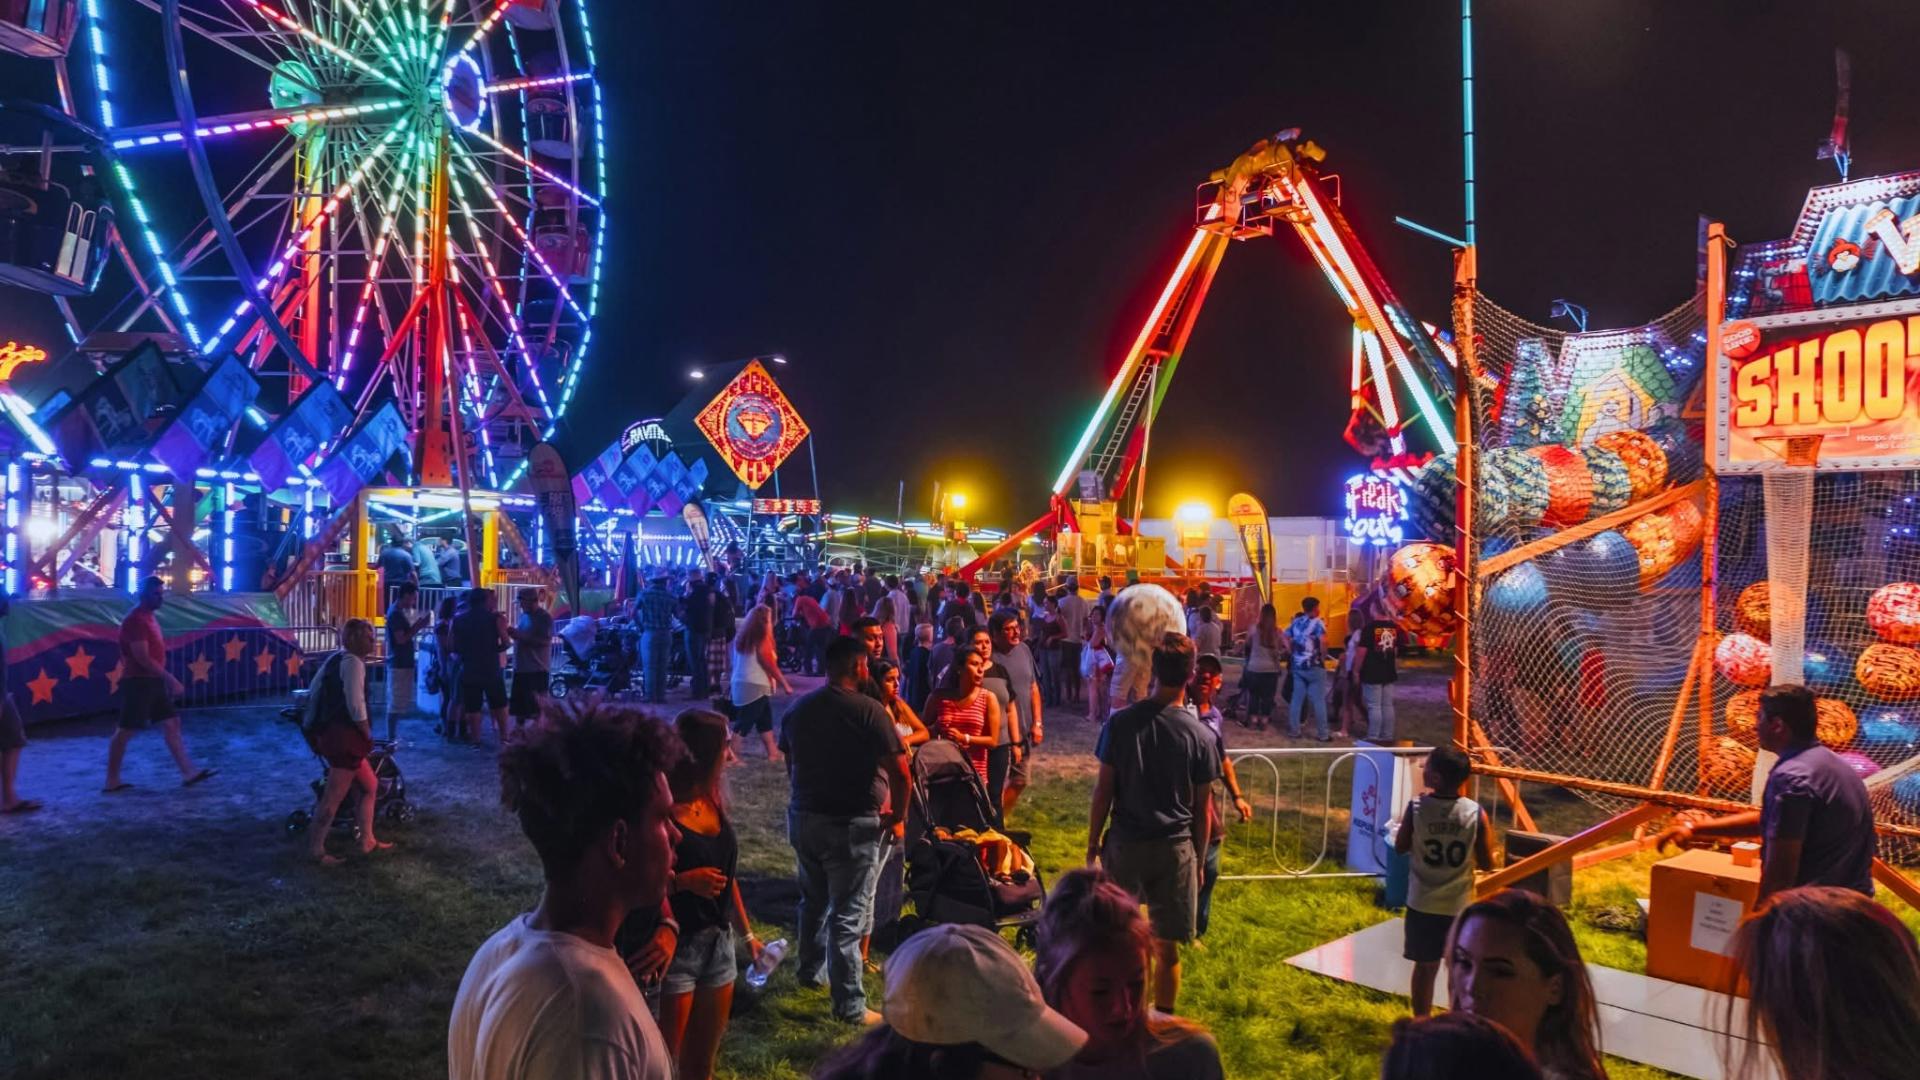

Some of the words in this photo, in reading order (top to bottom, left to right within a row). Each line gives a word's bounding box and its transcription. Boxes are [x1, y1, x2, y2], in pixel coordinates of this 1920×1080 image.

[1350, 482, 1400, 520] Freak
[1352, 513, 1396, 538] out
[1423, 838, 1467, 868] 30
